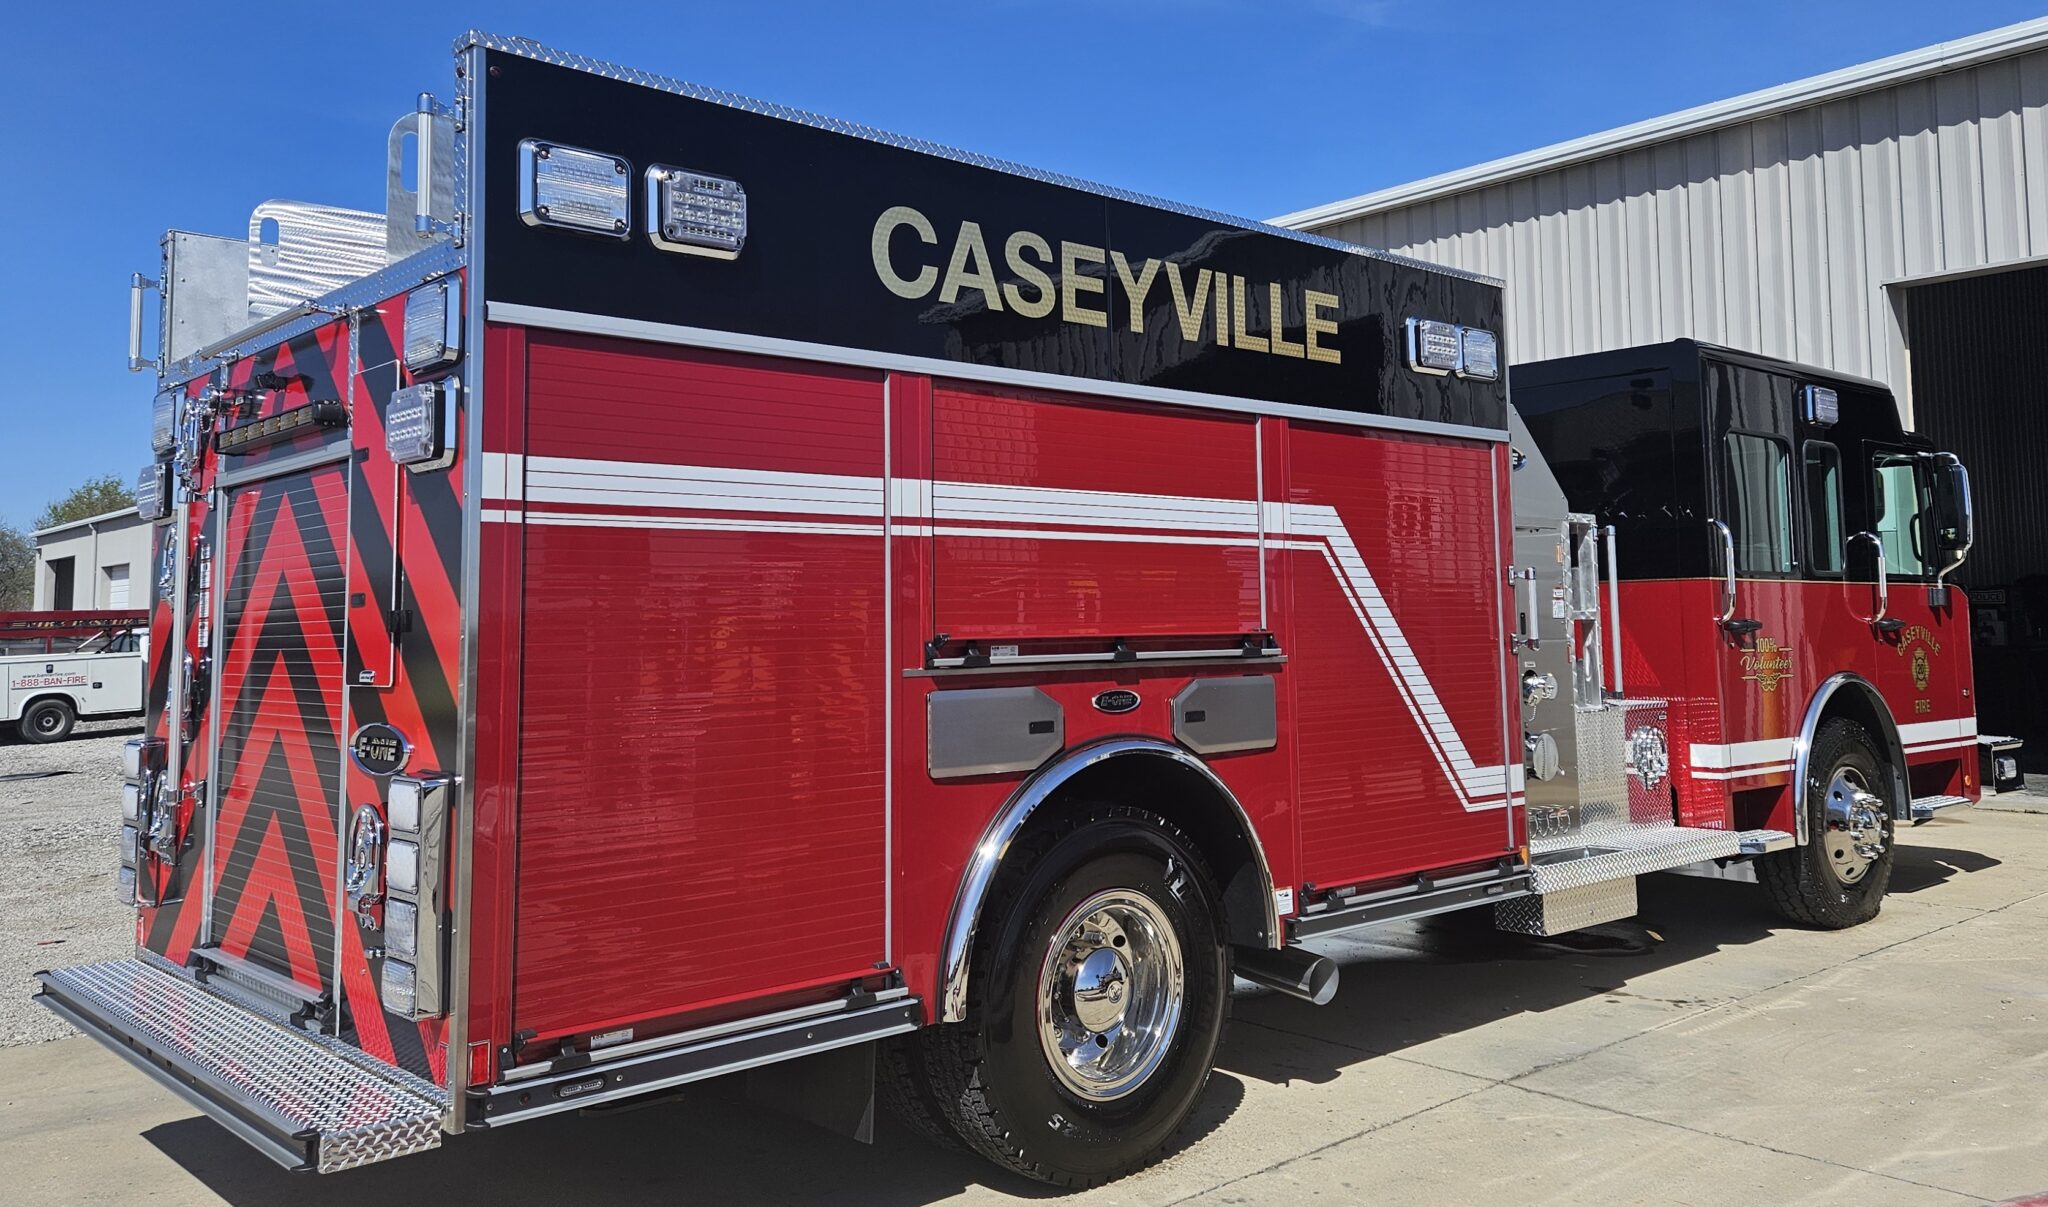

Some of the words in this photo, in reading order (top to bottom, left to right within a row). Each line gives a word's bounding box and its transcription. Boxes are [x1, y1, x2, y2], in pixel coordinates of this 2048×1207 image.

[871, 205, 1342, 365] CASEYVILLE
[1756, 637, 1778, 653] 100%
[1897, 625, 1941, 657] CASEYVILLE
[1740, 655, 1792, 670] Volunteer
[12, 676, 86, 687] 1-888-BAN-FIRE
[1915, 698, 1932, 714] FIRE
